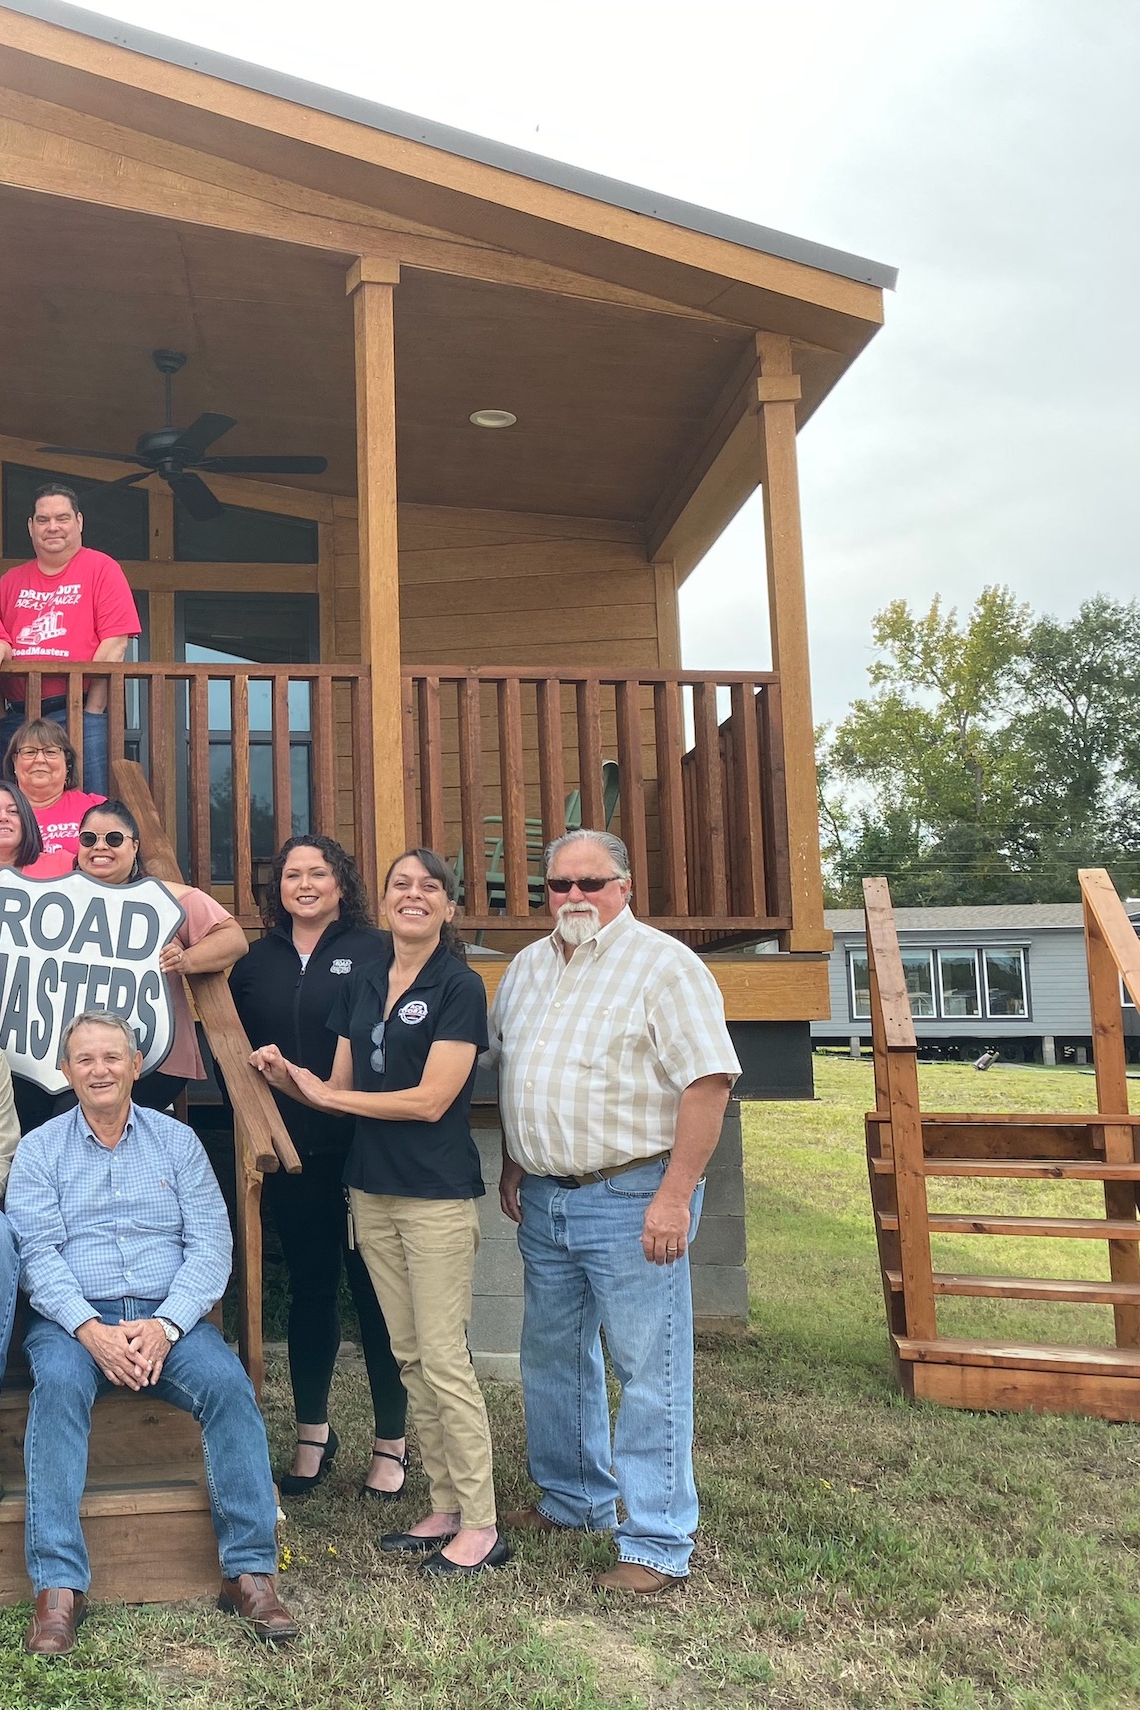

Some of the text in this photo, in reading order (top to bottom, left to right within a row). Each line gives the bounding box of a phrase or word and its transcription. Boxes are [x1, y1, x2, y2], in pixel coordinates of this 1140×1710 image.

[19, 589, 56, 602] DRIV
[14, 599, 49, 611] BREAS
[46, 822, 79, 833] OUT
